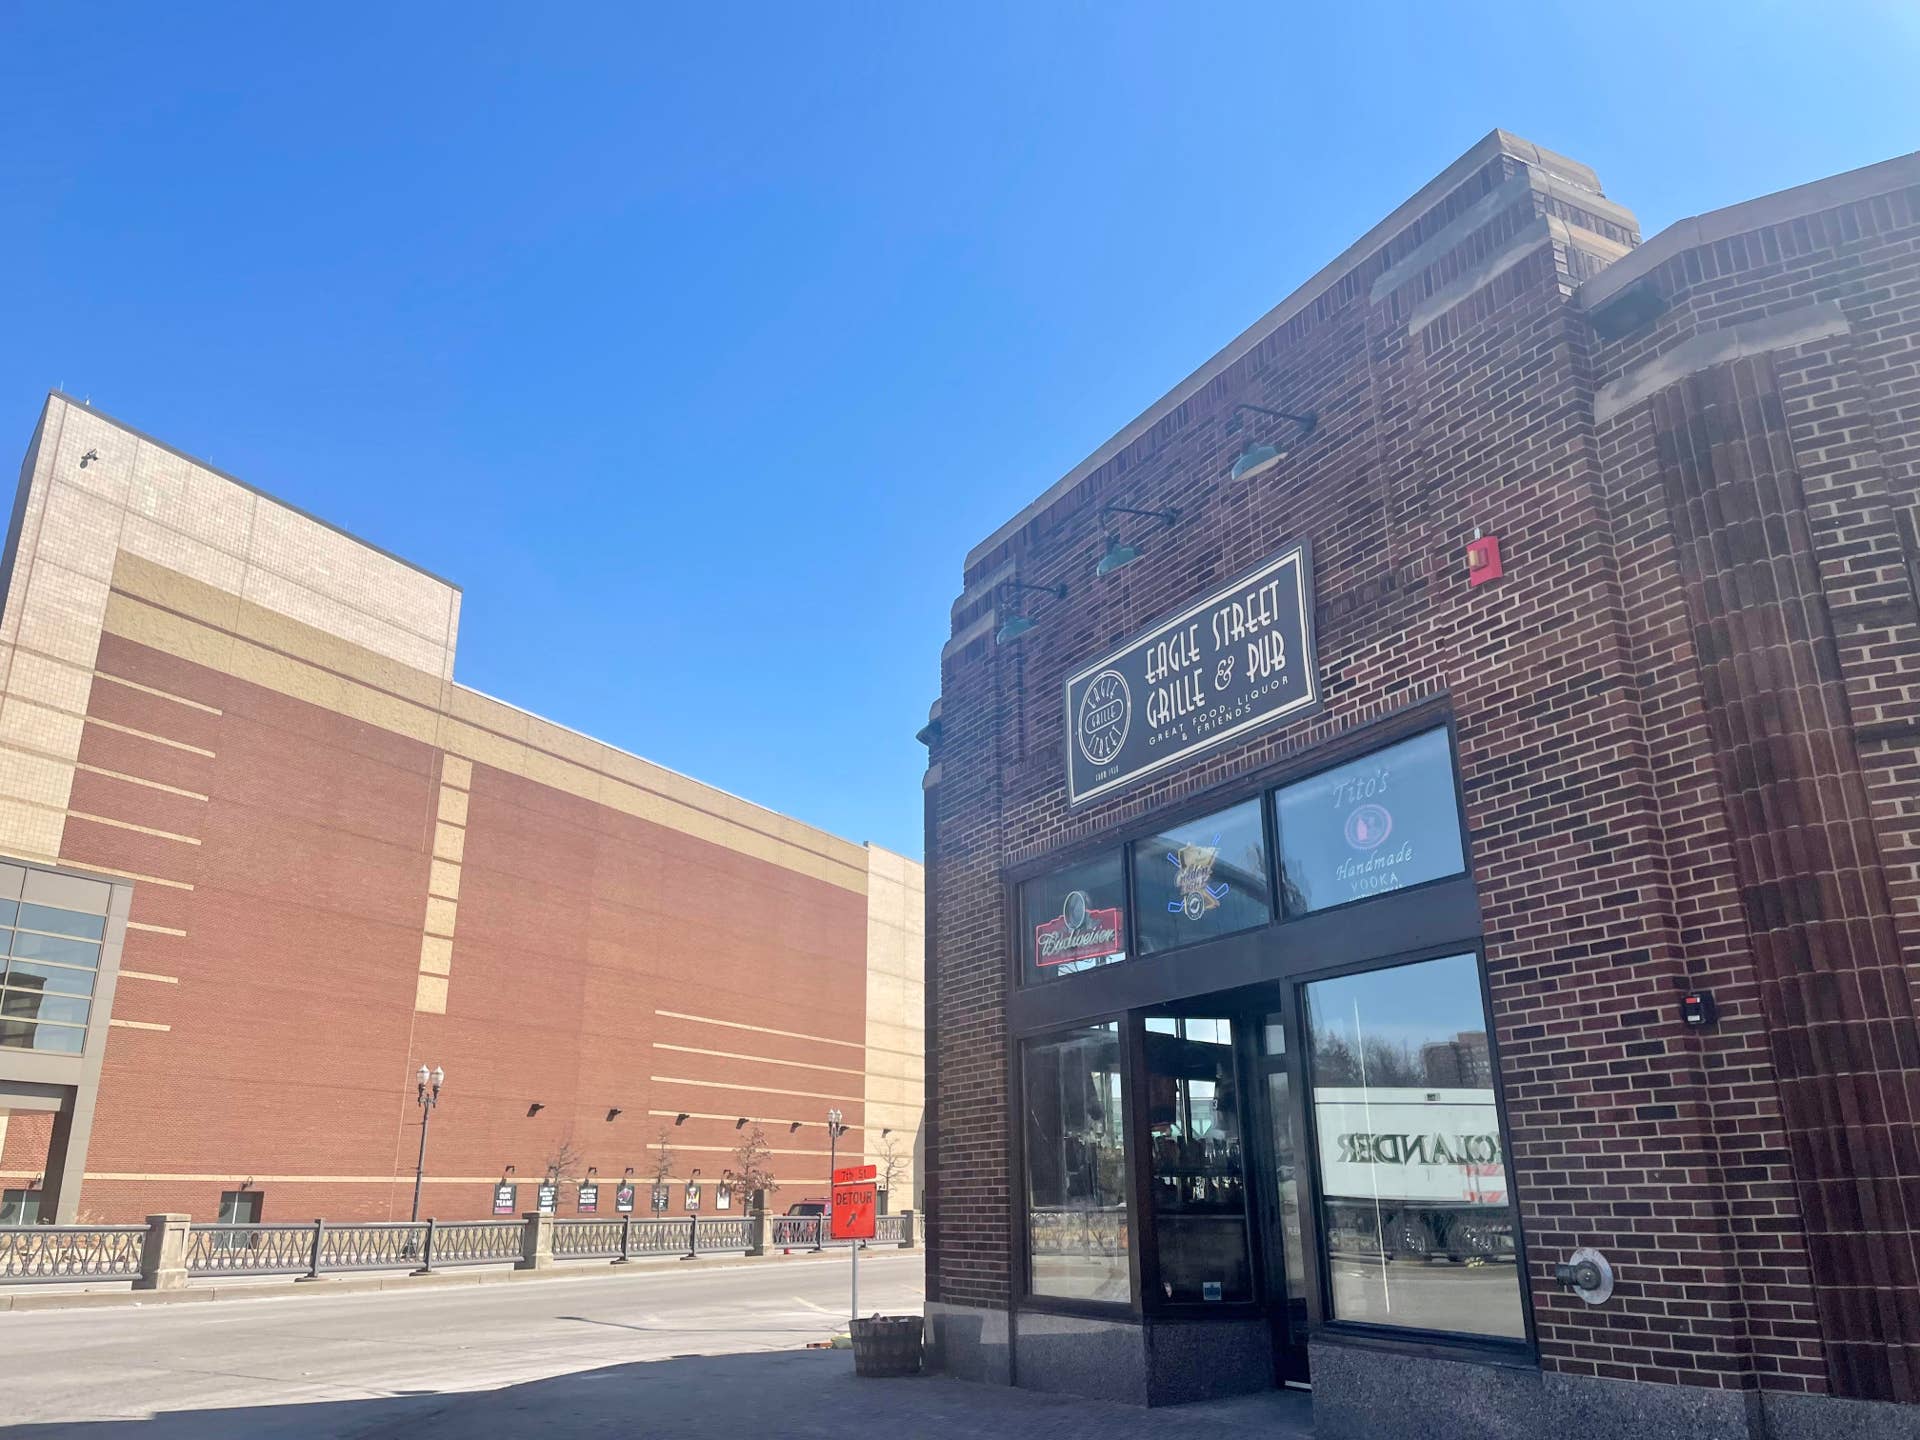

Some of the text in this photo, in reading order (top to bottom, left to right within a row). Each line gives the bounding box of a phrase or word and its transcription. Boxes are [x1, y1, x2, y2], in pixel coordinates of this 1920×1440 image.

[1145, 580, 1279, 684] EAGLE STREET
[1087, 679, 1118, 709] EAGLE
[1146, 630, 1286, 728] GRILLE & PUB
[1091, 705, 1116, 728] GRILLE
[1149, 724, 1184, 745] GREAT
[1237, 676, 1289, 705] LIQUOR
[1198, 706, 1251, 735] FRIENDS
[1088, 725, 1121, 757] STREET
[1333, 769, 1389, 808] Tito's
[1336, 840, 1413, 881] Handmade
[1038, 926, 1115, 957] Budweiser
[836, 1191, 872, 1206] DETOUR
